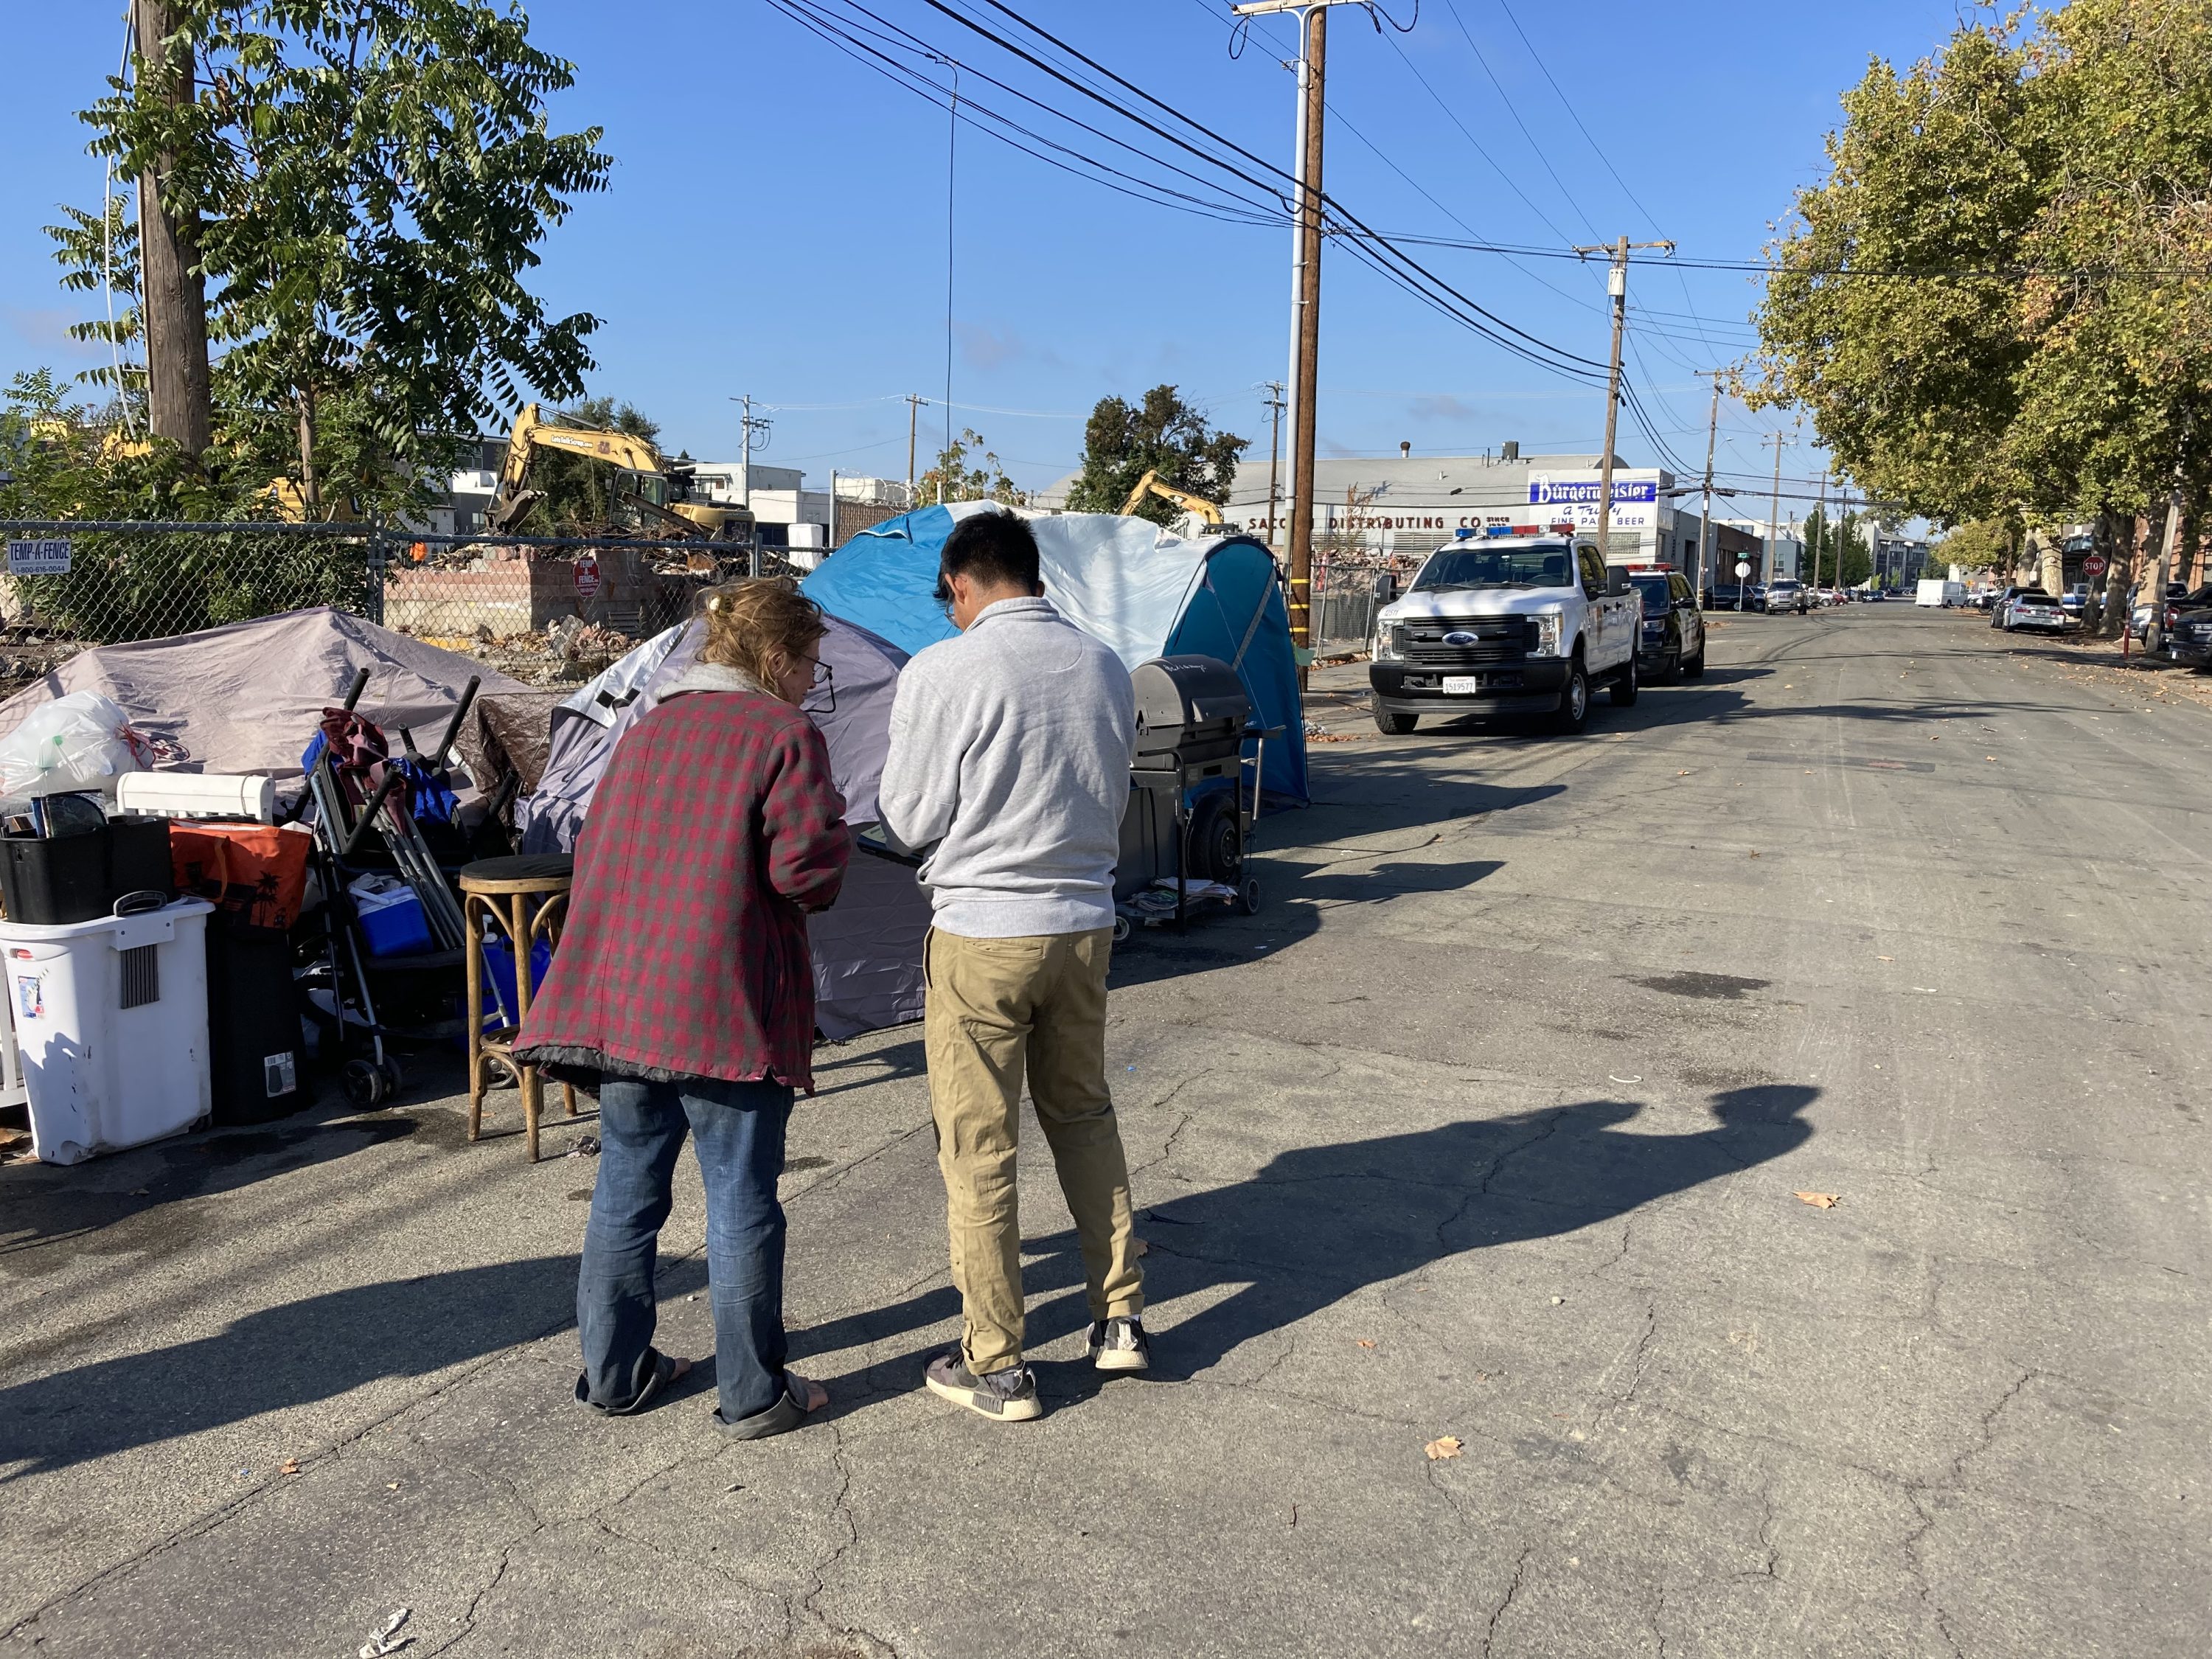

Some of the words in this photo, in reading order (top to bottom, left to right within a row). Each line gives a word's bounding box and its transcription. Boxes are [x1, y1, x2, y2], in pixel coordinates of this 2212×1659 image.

[1329, 517, 1444, 529] DISTRIBUTING
[10, 542, 69, 560] TEMP-A-FENCE
[580, 560, 594, 568] TEMP
[2084, 562, 2104, 570] STOP
[578, 575, 594, 583] FENCE
[1445, 683, 1472, 691] 1519577
